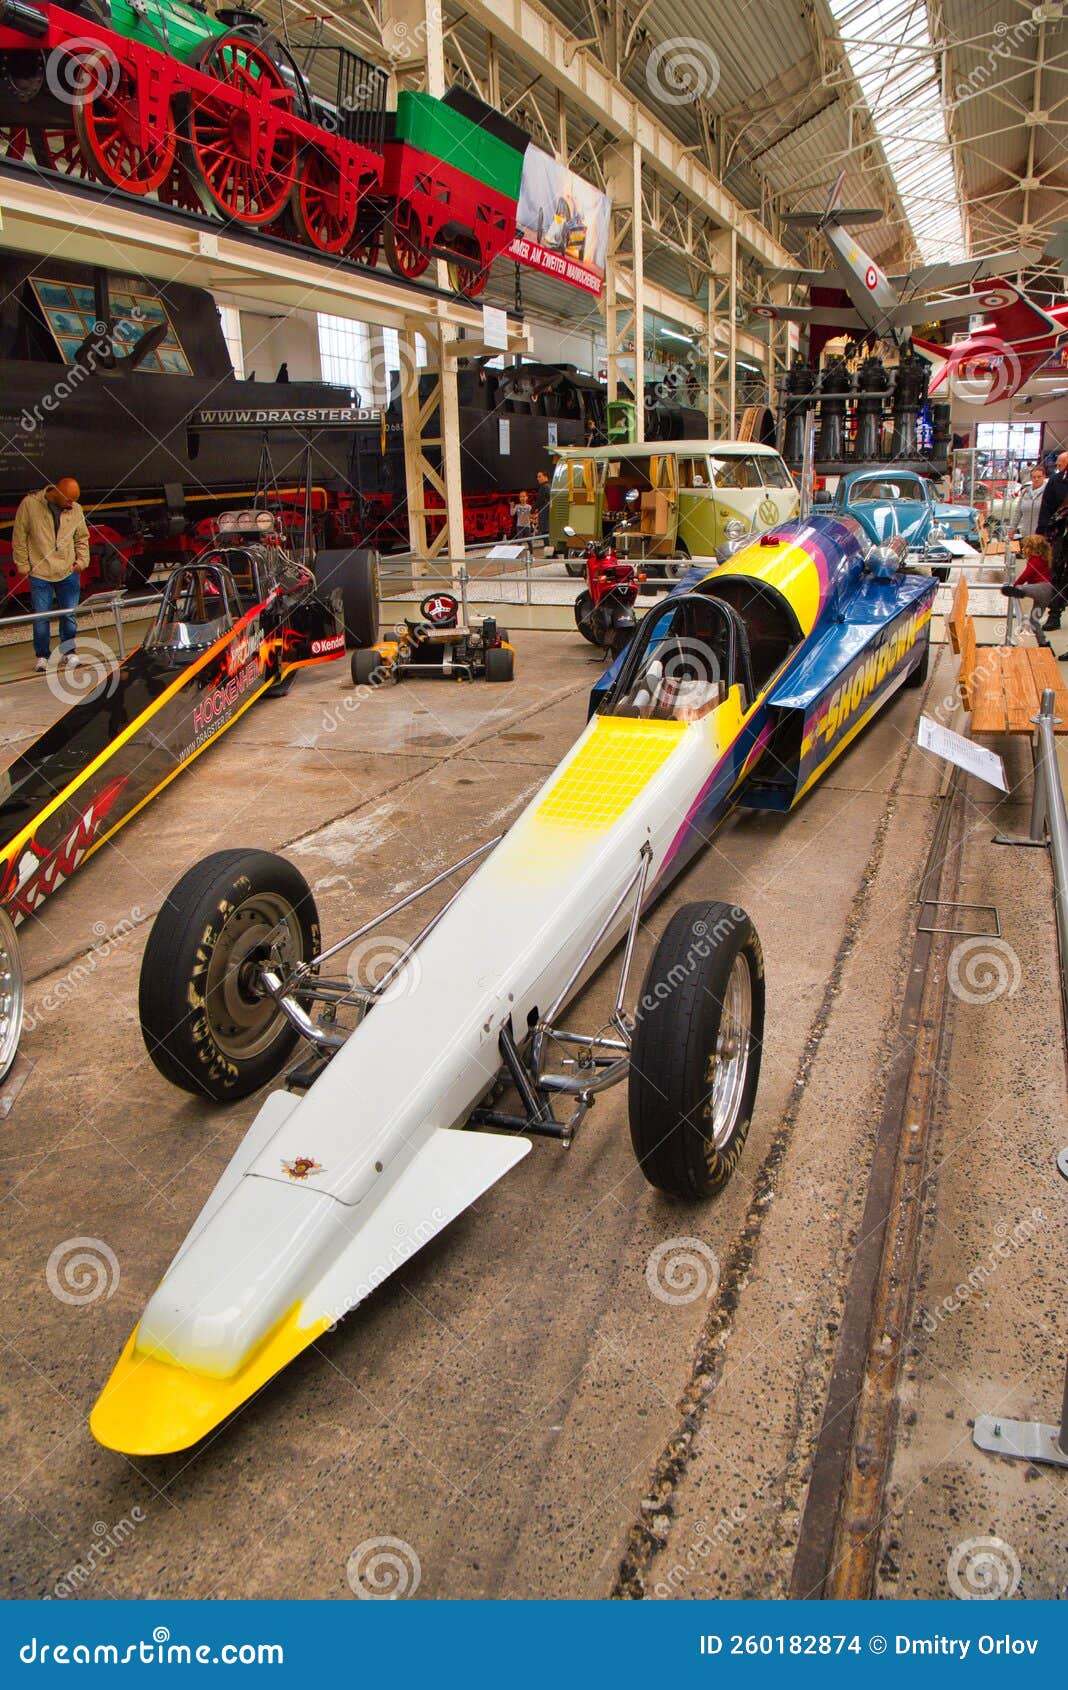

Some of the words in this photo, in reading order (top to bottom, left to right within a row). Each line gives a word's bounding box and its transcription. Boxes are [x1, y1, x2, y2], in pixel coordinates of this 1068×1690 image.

[530, 247, 542, 264] AM
[541, 251, 567, 275] ZWEITEN
[200, 409, 381, 424] WWW.DRAGSTER.DE
[825, 613, 917, 743] SHOWDOWN
